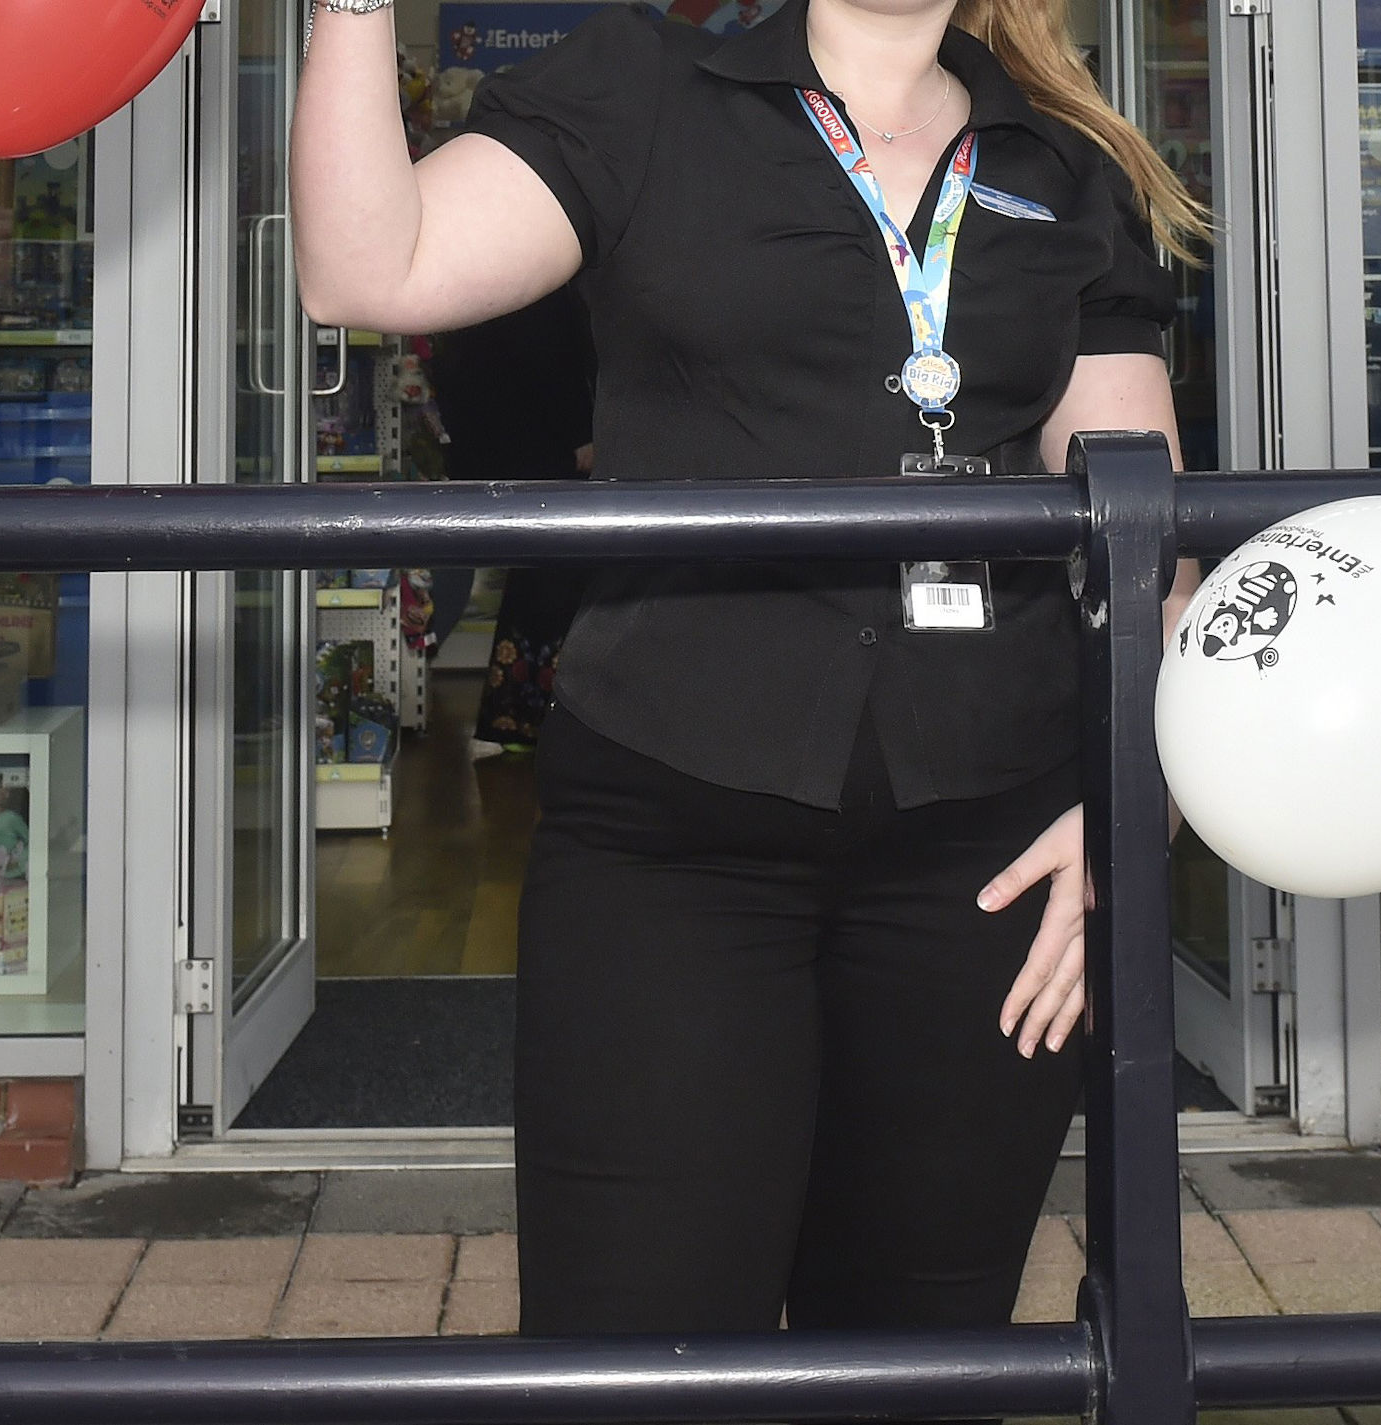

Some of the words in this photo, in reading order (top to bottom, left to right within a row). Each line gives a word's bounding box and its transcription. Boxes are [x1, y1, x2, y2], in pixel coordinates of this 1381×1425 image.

[495, 28, 568, 49] Entert
[909, 367, 929, 383] Big
[932, 373, 953, 389] Kid
[1351, 564, 1375, 579] The
